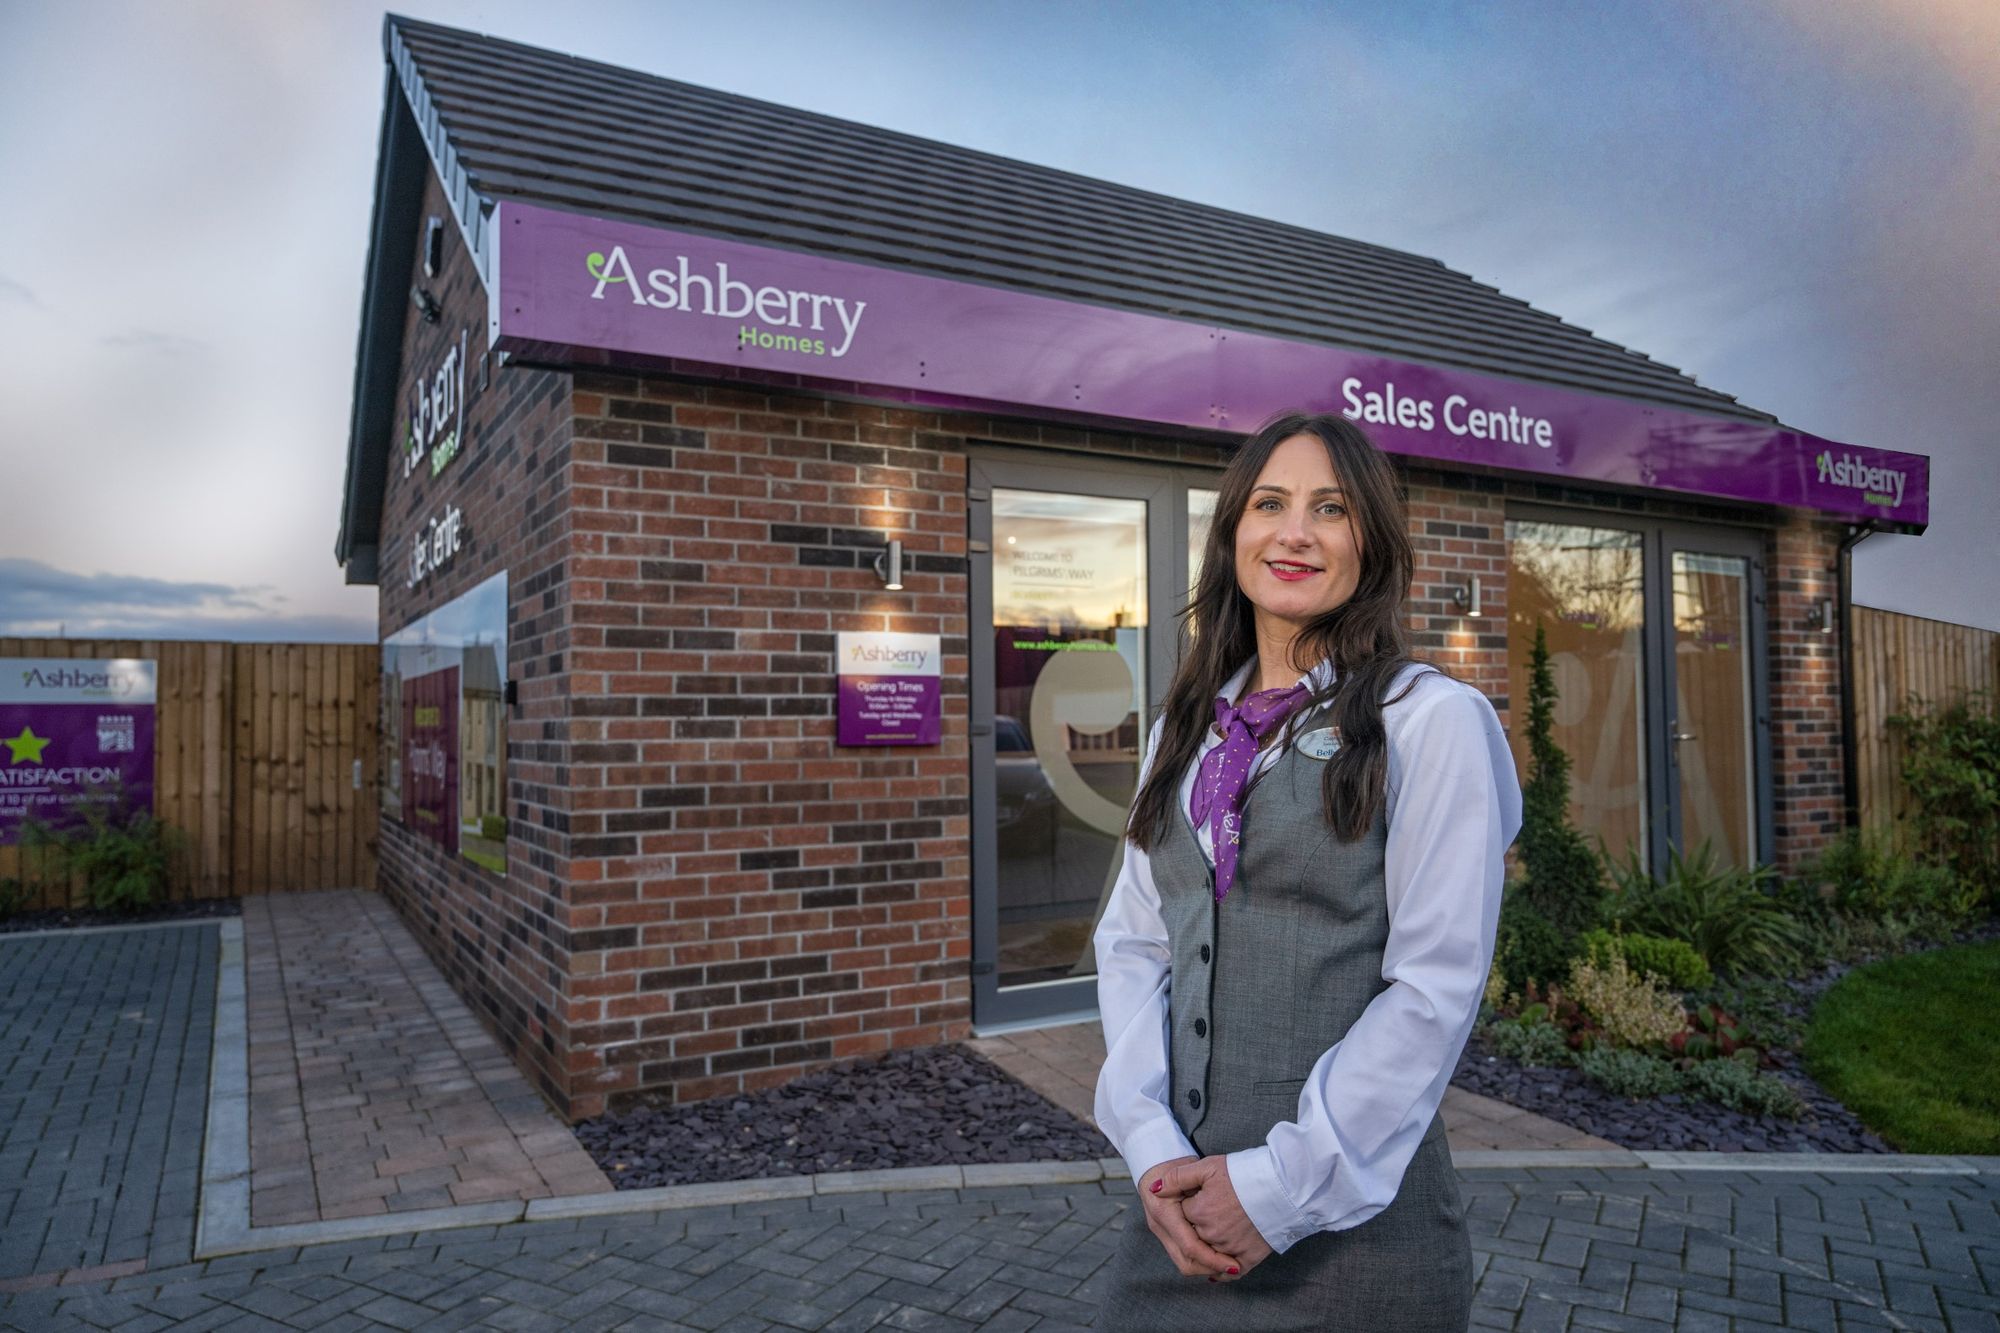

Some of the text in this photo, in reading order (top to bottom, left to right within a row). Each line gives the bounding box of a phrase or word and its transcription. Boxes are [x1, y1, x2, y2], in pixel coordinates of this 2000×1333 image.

[587, 245, 867, 357] Ashberry
[740, 326, 825, 355] Homes
[1342, 377, 1553, 448] Sales Centre
[1816, 450, 1907, 508] Ashberry
[1067, 569, 1095, 579] WAY
[850, 645, 928, 669] Ashberry
[22, 668, 137, 696] Ashberry
[857, 680, 924, 694] Opening Times
